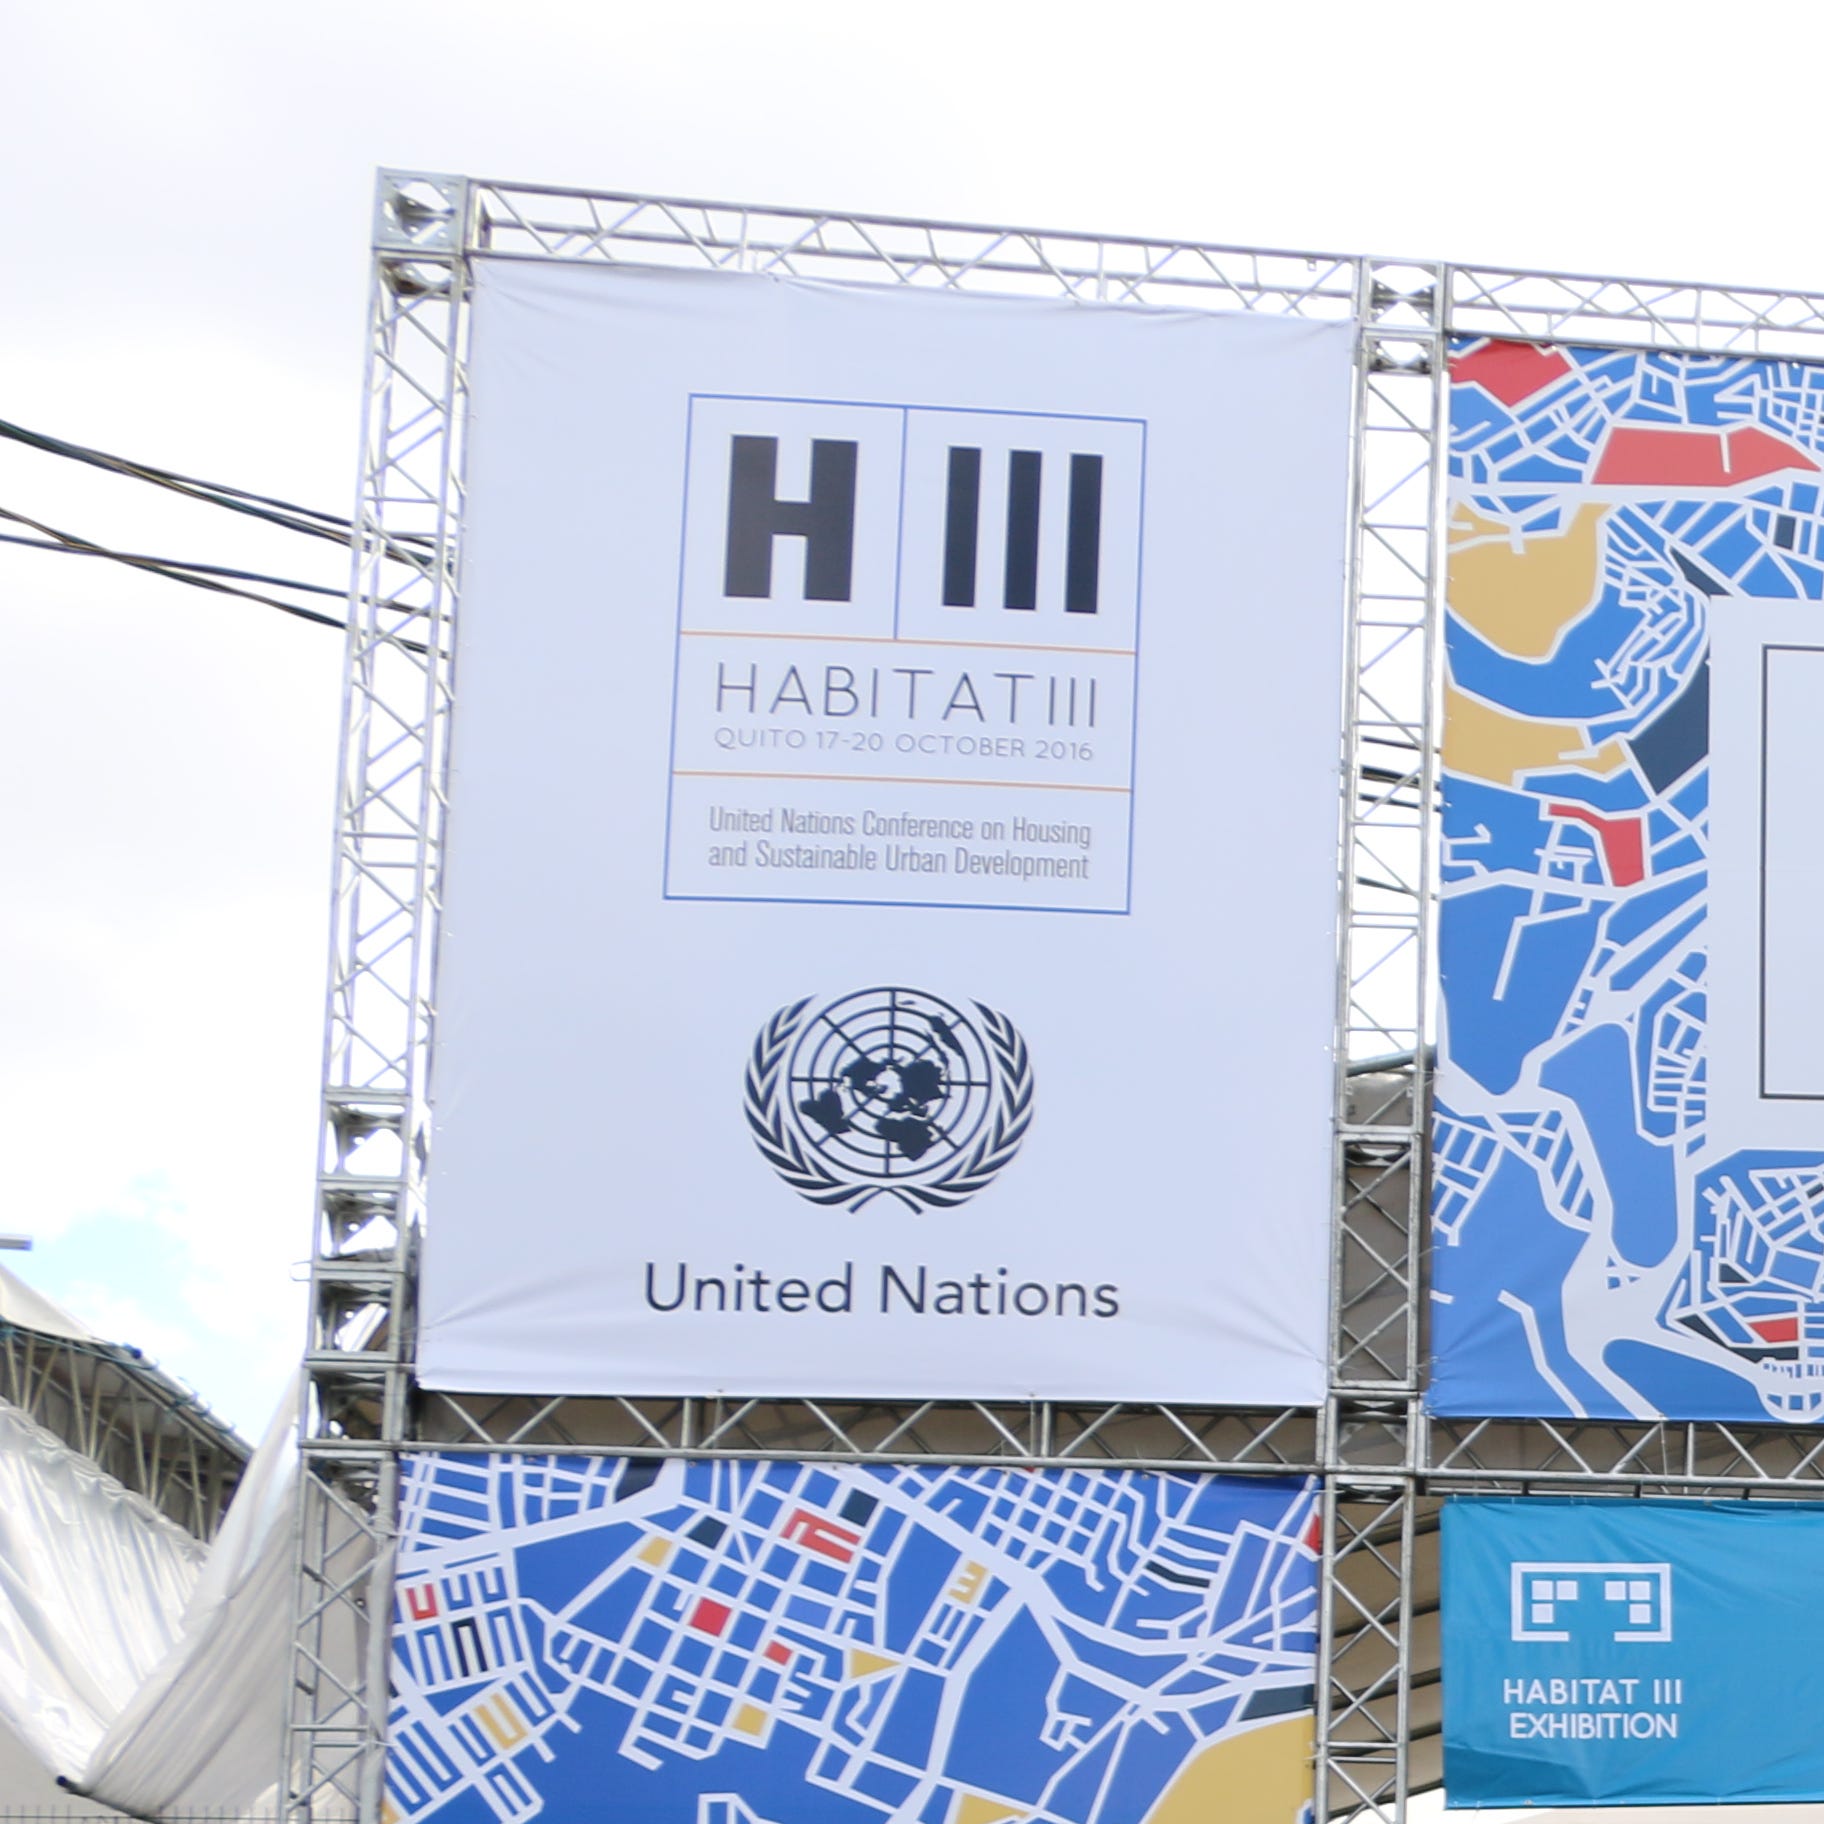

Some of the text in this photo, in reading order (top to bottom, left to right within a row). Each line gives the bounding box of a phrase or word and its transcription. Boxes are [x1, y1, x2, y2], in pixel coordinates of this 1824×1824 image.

[723, 433, 1103, 614] H III
[714, 726, 1093, 762] QUITO 17-20 OCTOBER 2016
[709, 805, 1092, 850] United Nations Conference on Housing
[708, 839, 1090, 881] and Sustainable Urban Development
[643, 1260, 1120, 1319] United Nations
[1503, 1678, 1682, 1705] HABITAT III
[1510, 1712, 1678, 1739] EXHIBITION
